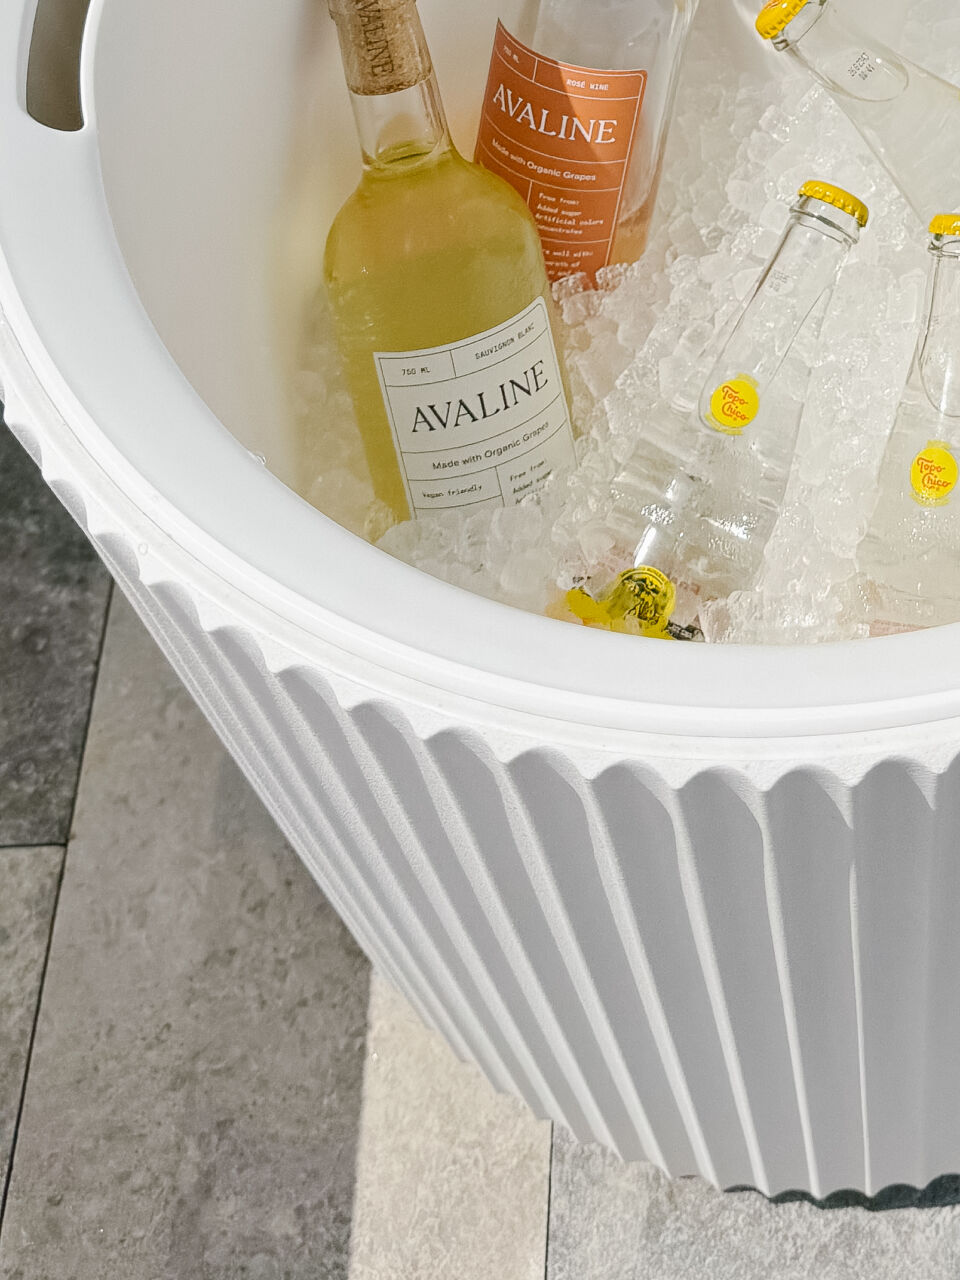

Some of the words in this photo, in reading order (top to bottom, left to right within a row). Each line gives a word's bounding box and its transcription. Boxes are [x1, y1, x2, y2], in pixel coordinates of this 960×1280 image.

[493, 83, 618, 144] AVALINE
[526, 161, 561, 177] Organic
[563, 170, 597, 181] Grapes
[475, 336, 515, 360] SAUVIGNON
[517, 322, 535, 340] BLANC
[401, 368, 417, 377] 750
[420, 366, 431, 374] ML
[411, 359, 549, 433] AVALINE
[722, 385, 749, 404] Topo
[722, 401, 750, 421] Chico
[432, 460, 460, 470] Made
[462, 454, 482, 465] with
[484, 439, 521, 458] Organic
[522, 422, 549, 442] Grapes
[917, 457, 946, 473] Topo
[922, 472, 951, 488] Chico
